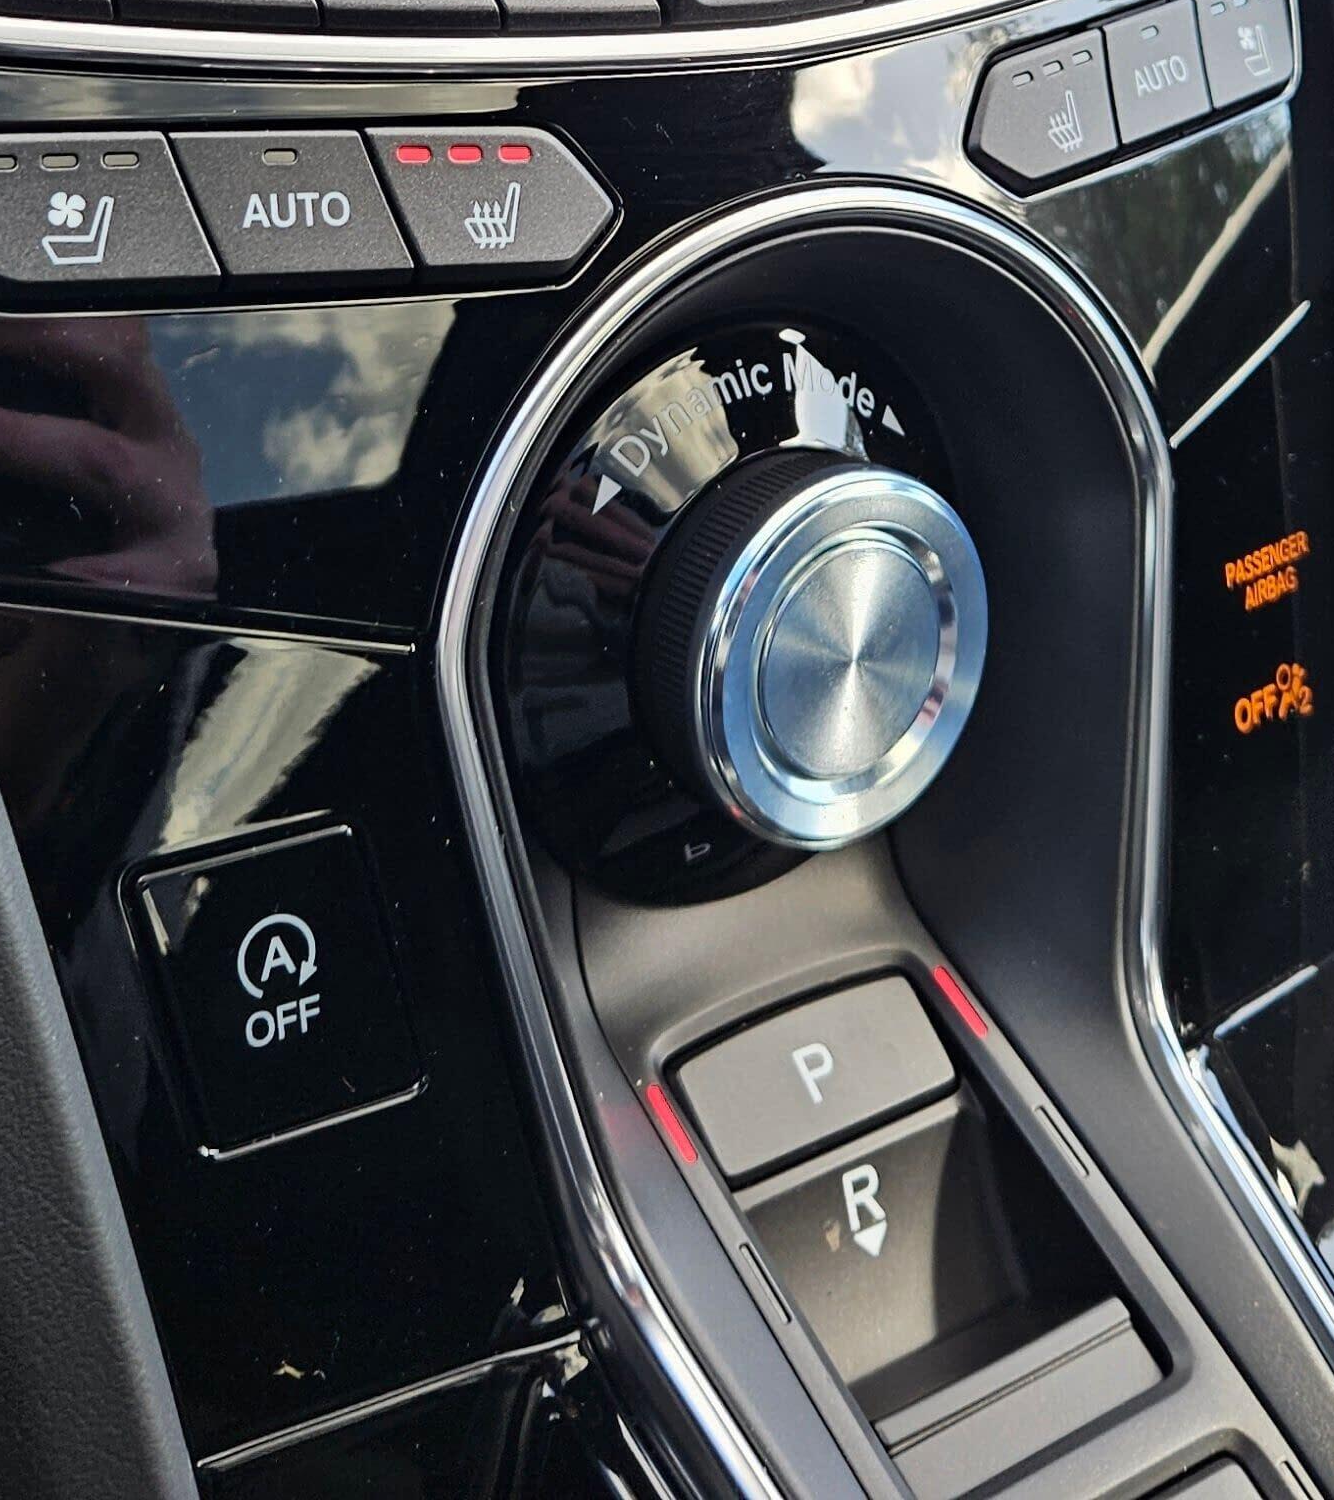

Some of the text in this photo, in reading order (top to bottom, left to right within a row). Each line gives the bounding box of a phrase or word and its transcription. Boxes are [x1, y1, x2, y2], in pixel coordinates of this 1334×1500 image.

[1134, 55, 1186, 97] AUTO
[243, 191, 351, 230] AUTO
[610, 352, 876, 477] Dynamic Mode
[1225, 530, 1310, 588] PASSENGER
[1245, 566, 1298, 611] AIRBAG
[1234, 683, 1277, 735] OFF
[245, 994, 320, 1048] OFF
[791, 1043, 834, 1103] P
[841, 1163, 887, 1232] R
